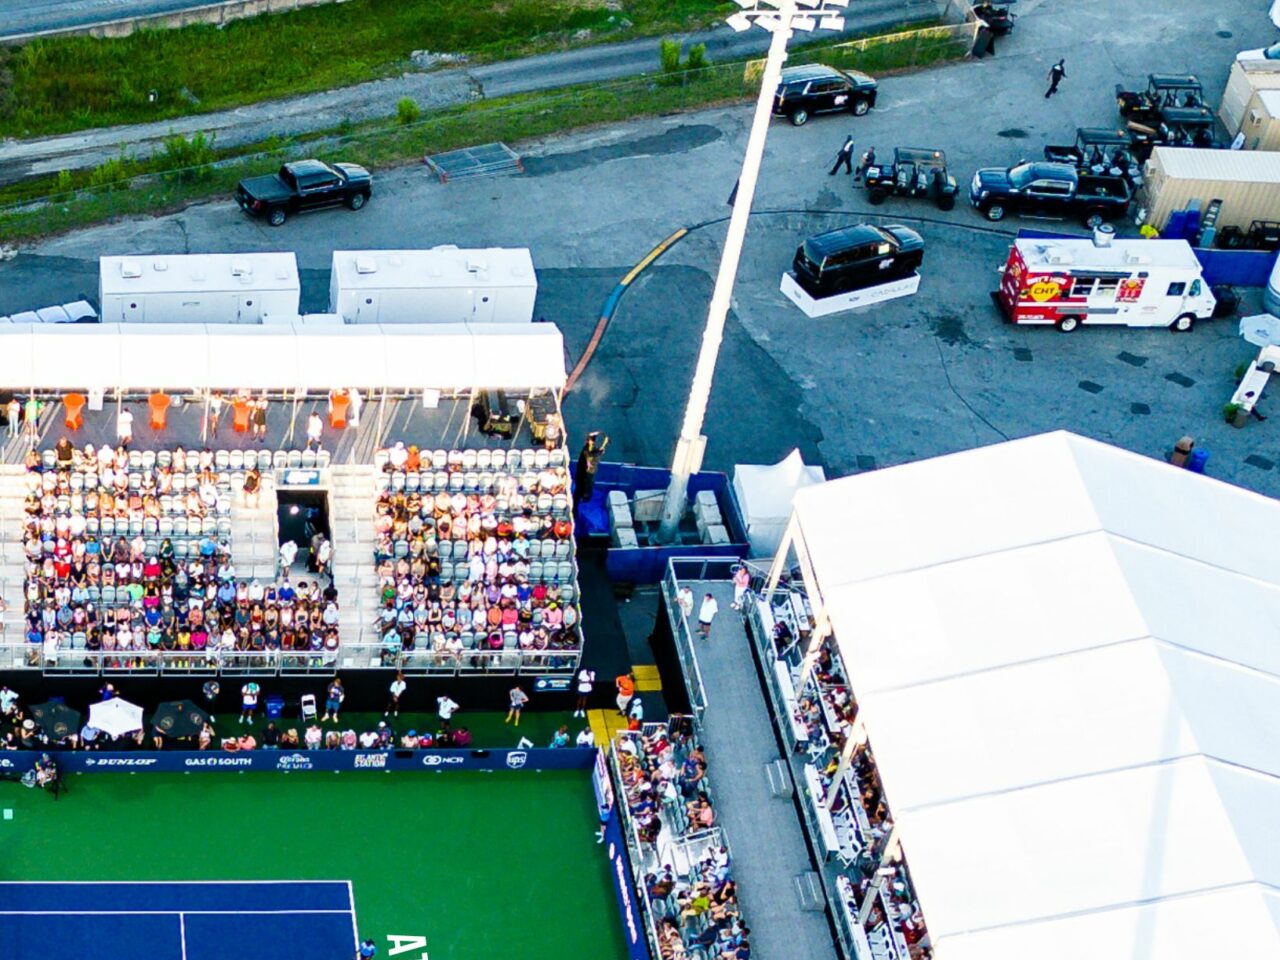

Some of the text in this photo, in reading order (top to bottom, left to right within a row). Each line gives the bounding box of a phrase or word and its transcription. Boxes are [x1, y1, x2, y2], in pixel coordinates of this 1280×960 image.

[97, 758, 158, 766] DUNLOP
[185, 757, 253, 766] GAS SOUTH
[442, 756, 465, 764] NCR
